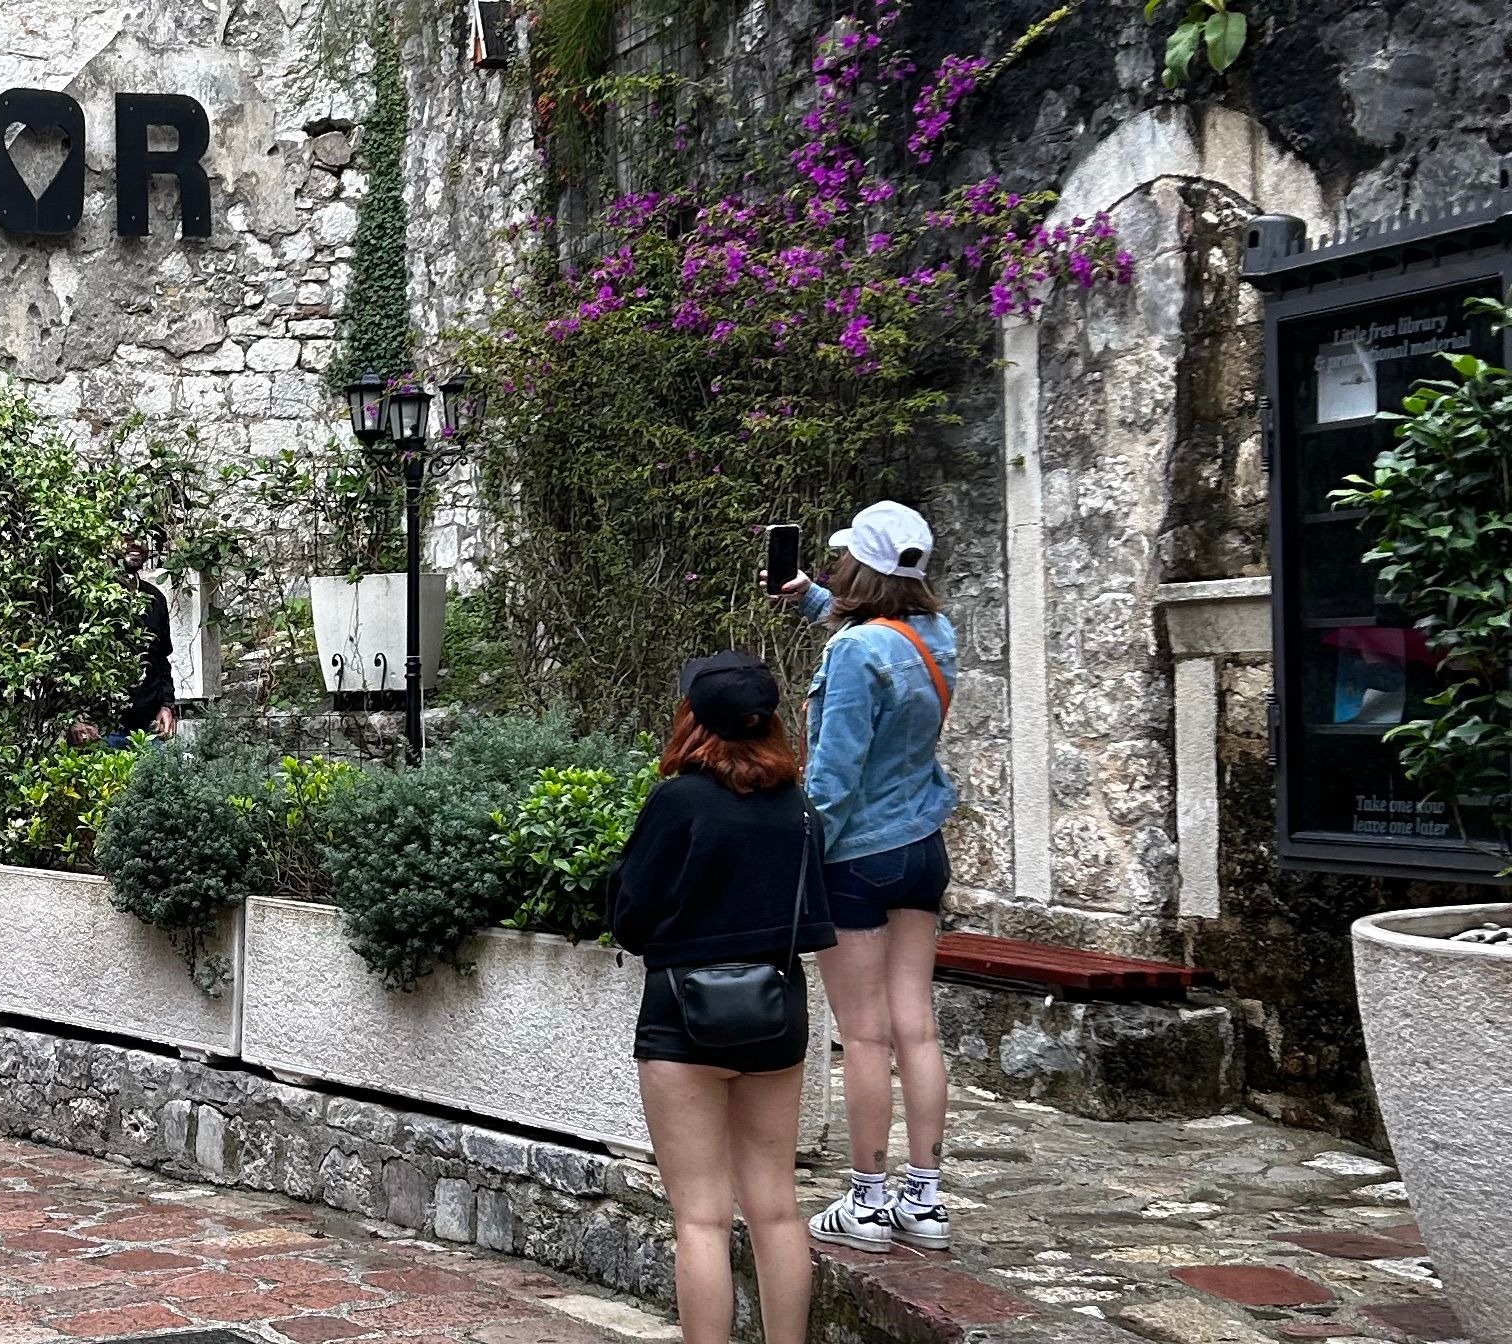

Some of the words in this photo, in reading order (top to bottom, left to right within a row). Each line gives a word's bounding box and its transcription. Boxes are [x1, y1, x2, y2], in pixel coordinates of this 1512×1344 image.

[1333, 325, 1367, 345] Little
[1366, 322, 1396, 345] free
[1398, 316, 1448, 335] library
[1328, 340, 1409, 374] promtional
[1410, 330, 1472, 356] material
[1355, 795, 1387, 812] Take
[1389, 800, 1413, 813] one
[1352, 815, 1387, 833] leave
[1389, 821, 1413, 835] one
[1415, 817, 1450, 836] later
